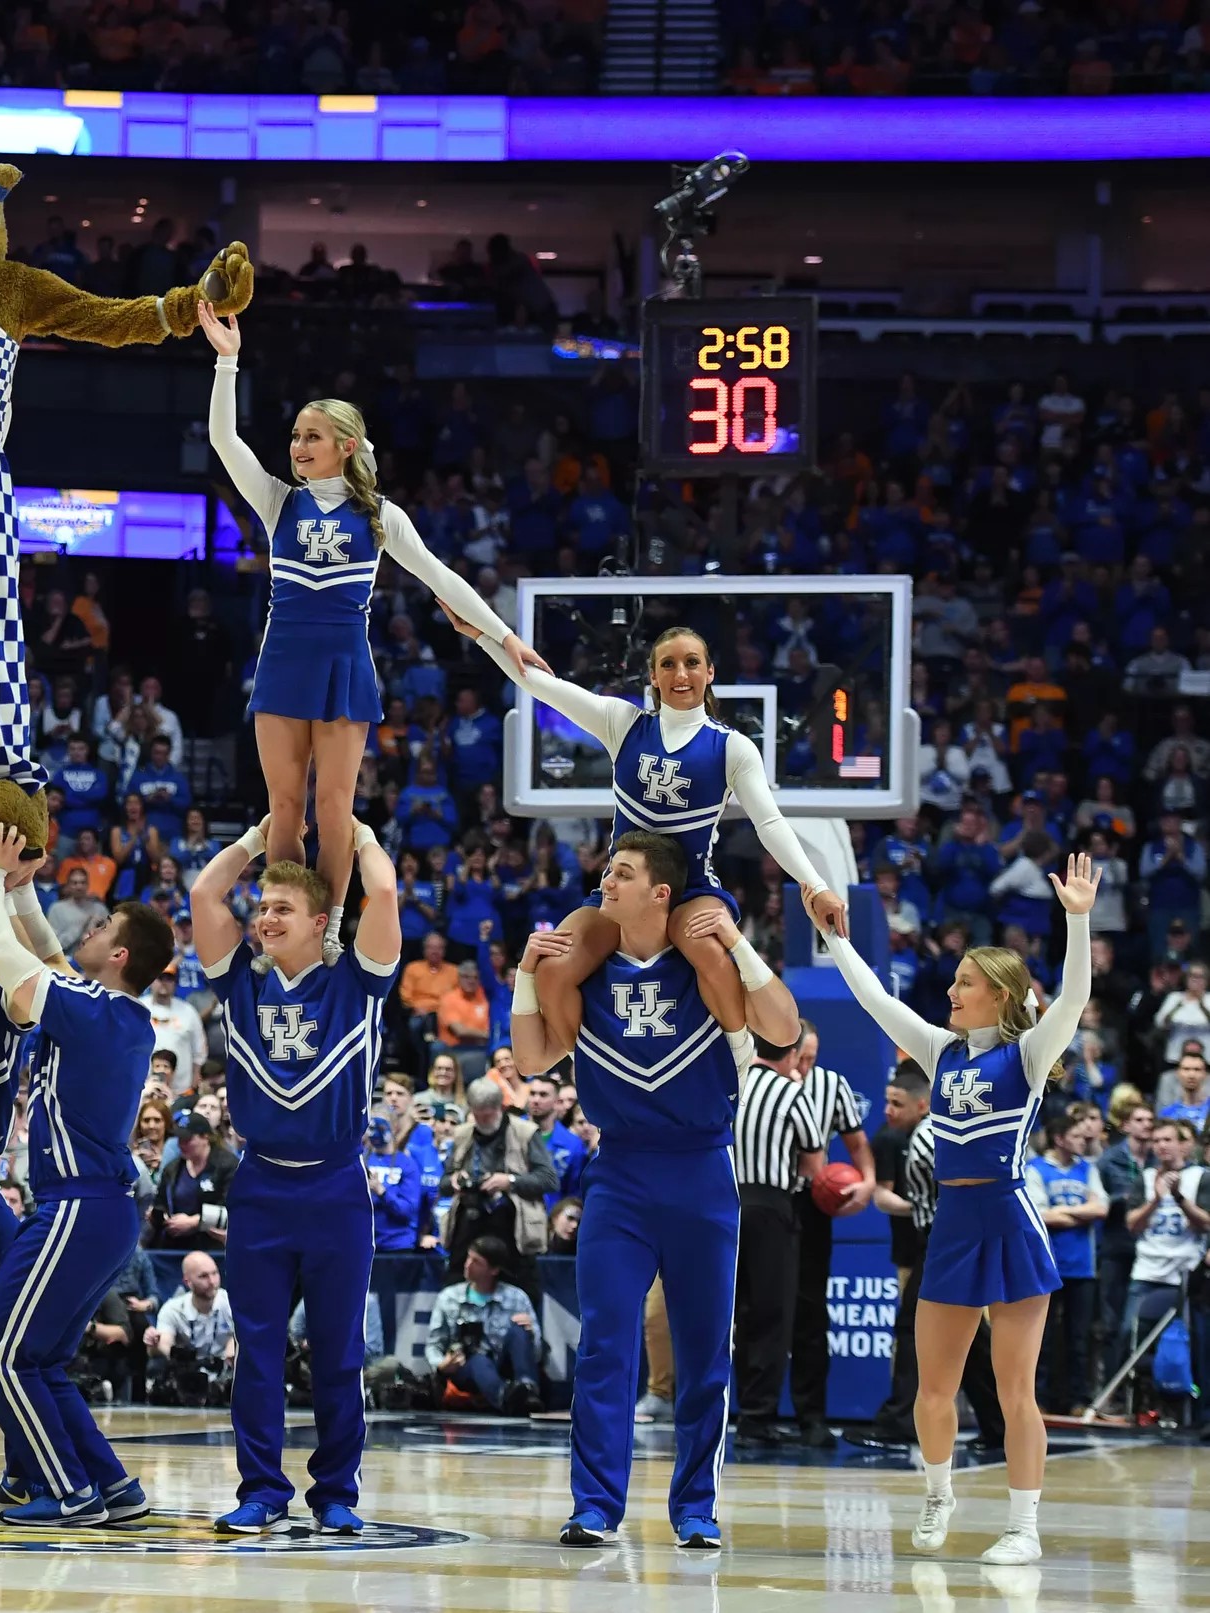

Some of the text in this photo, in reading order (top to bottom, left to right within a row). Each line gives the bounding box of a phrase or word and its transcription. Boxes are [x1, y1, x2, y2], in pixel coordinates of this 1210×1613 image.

[698, 326, 790, 370] 2:58
[689, 377, 776, 453] 30
[297, 519, 352, 563] UK
[637, 753, 691, 808] UK
[257, 1004, 319, 1061] UK
[611, 982, 676, 1038] UK
[941, 1069, 993, 1115] UK
[826, 1277, 899, 1300] IT JUS
[826, 1303, 896, 1327] MEAN
[826, 1331, 894, 1358] MOR
